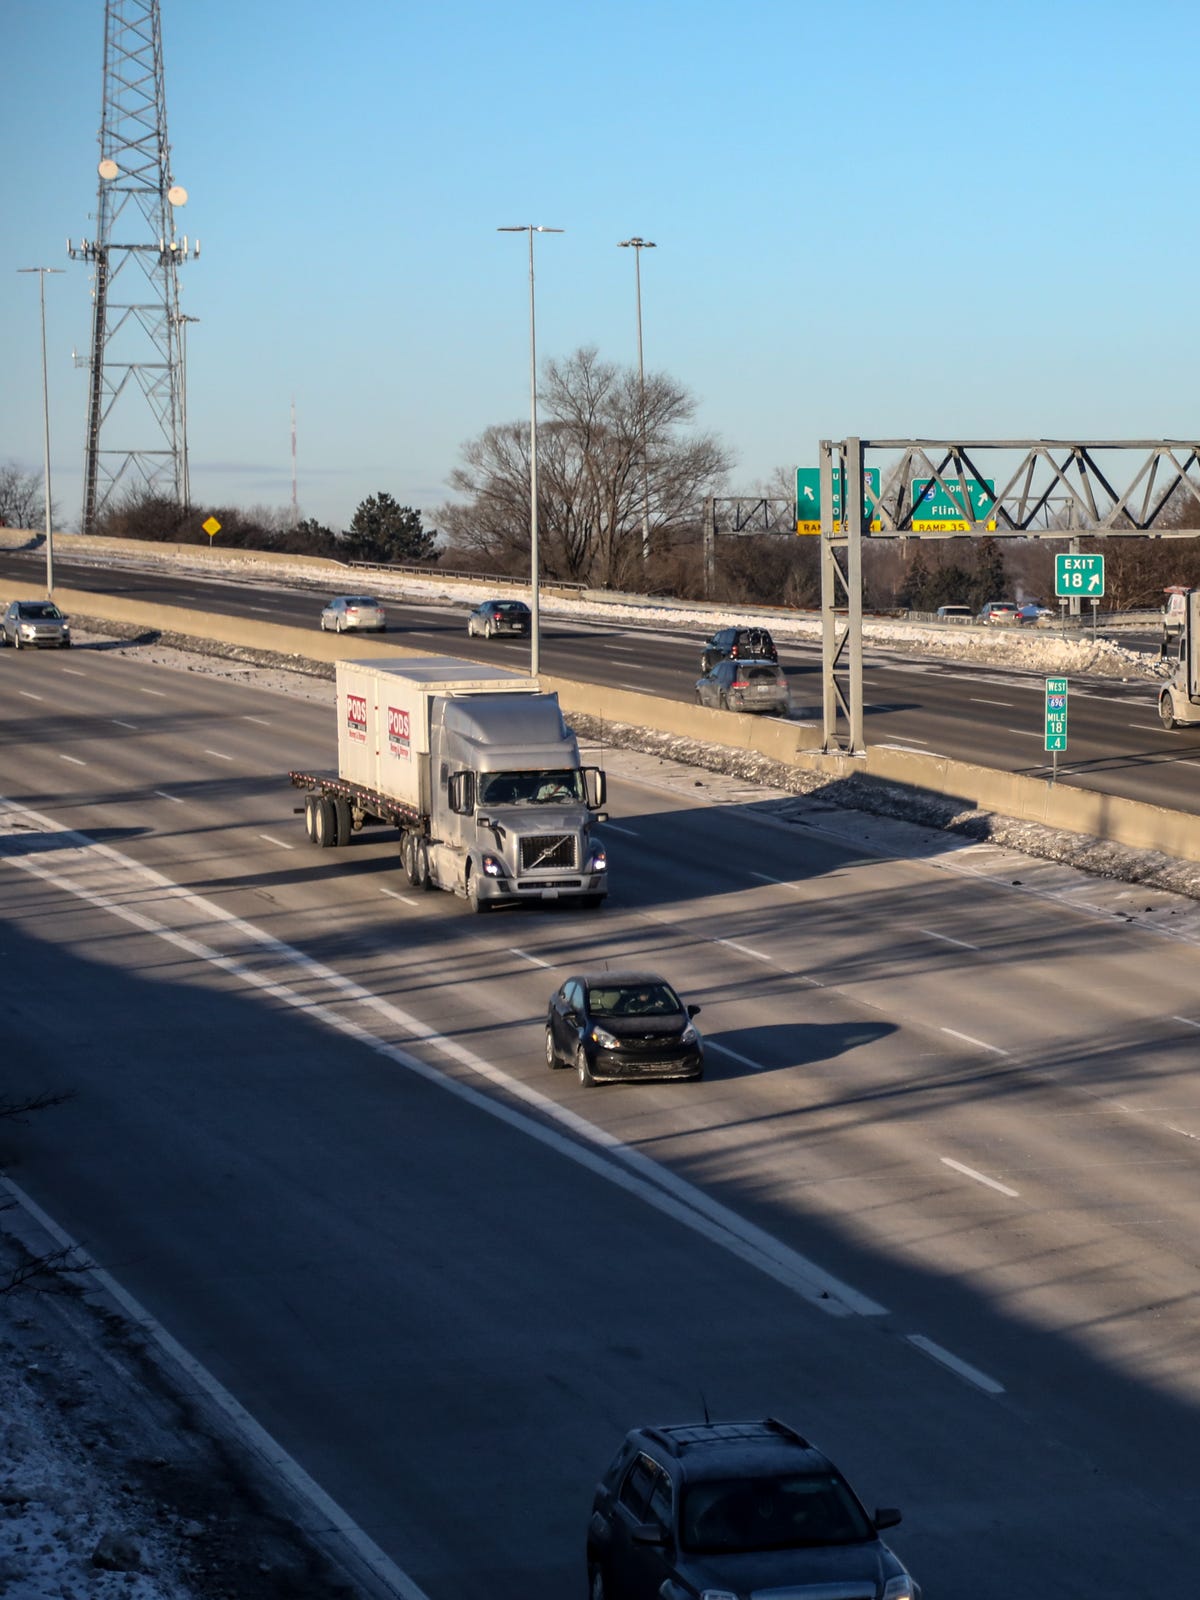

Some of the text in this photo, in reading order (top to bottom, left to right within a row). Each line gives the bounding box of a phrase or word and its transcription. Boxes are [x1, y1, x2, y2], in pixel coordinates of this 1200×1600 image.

[919, 523, 965, 532] RAMP 35
[1064, 559, 1095, 570] EXIT
[1062, 573, 1083, 588] 18
[1048, 681, 1066, 692] WEST
[1050, 698, 1063, 707] 696
[347, 698, 366, 723] PODS
[1047, 713, 1065, 722] MILE
[389, 710, 409, 737] PODS
[1050, 722, 1063, 733] 18
